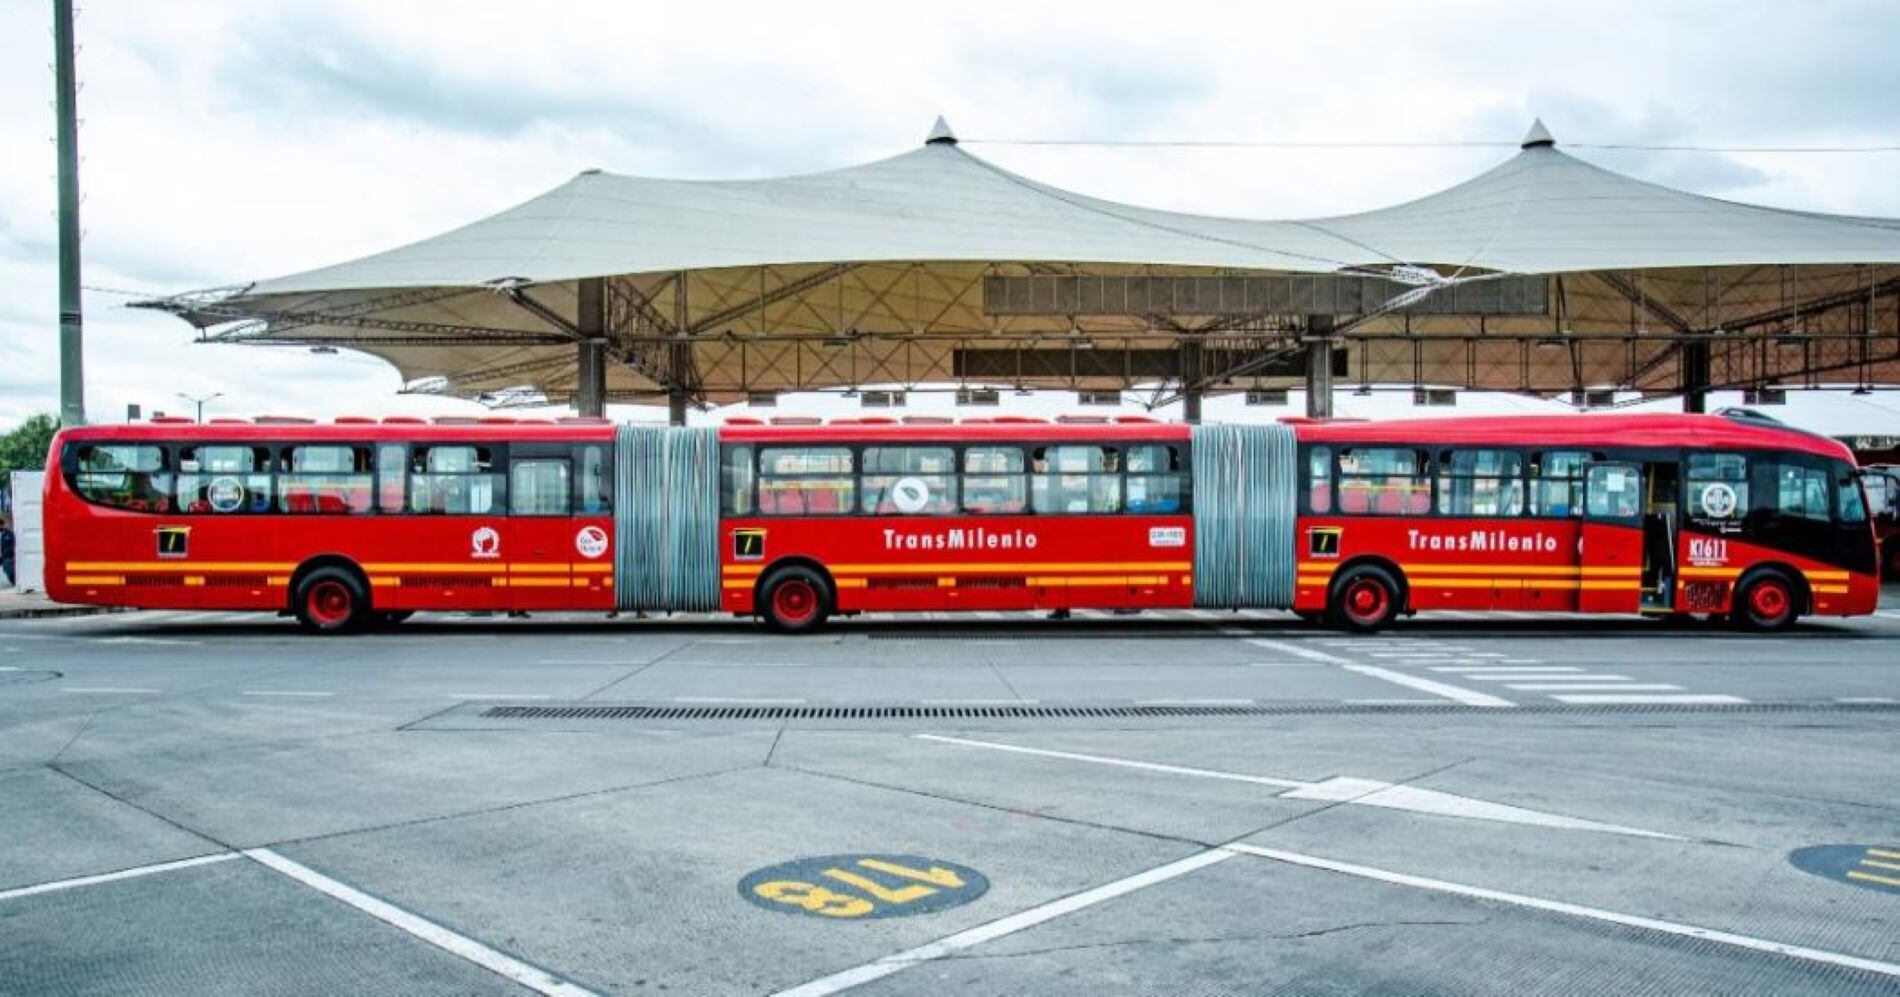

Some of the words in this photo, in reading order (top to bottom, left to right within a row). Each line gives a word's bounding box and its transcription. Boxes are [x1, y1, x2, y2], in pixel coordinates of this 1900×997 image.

[883, 527, 1037, 549] TransMilenio
[1407, 529, 1556, 551] TransMilenio
[753, 858, 967, 918] 178
